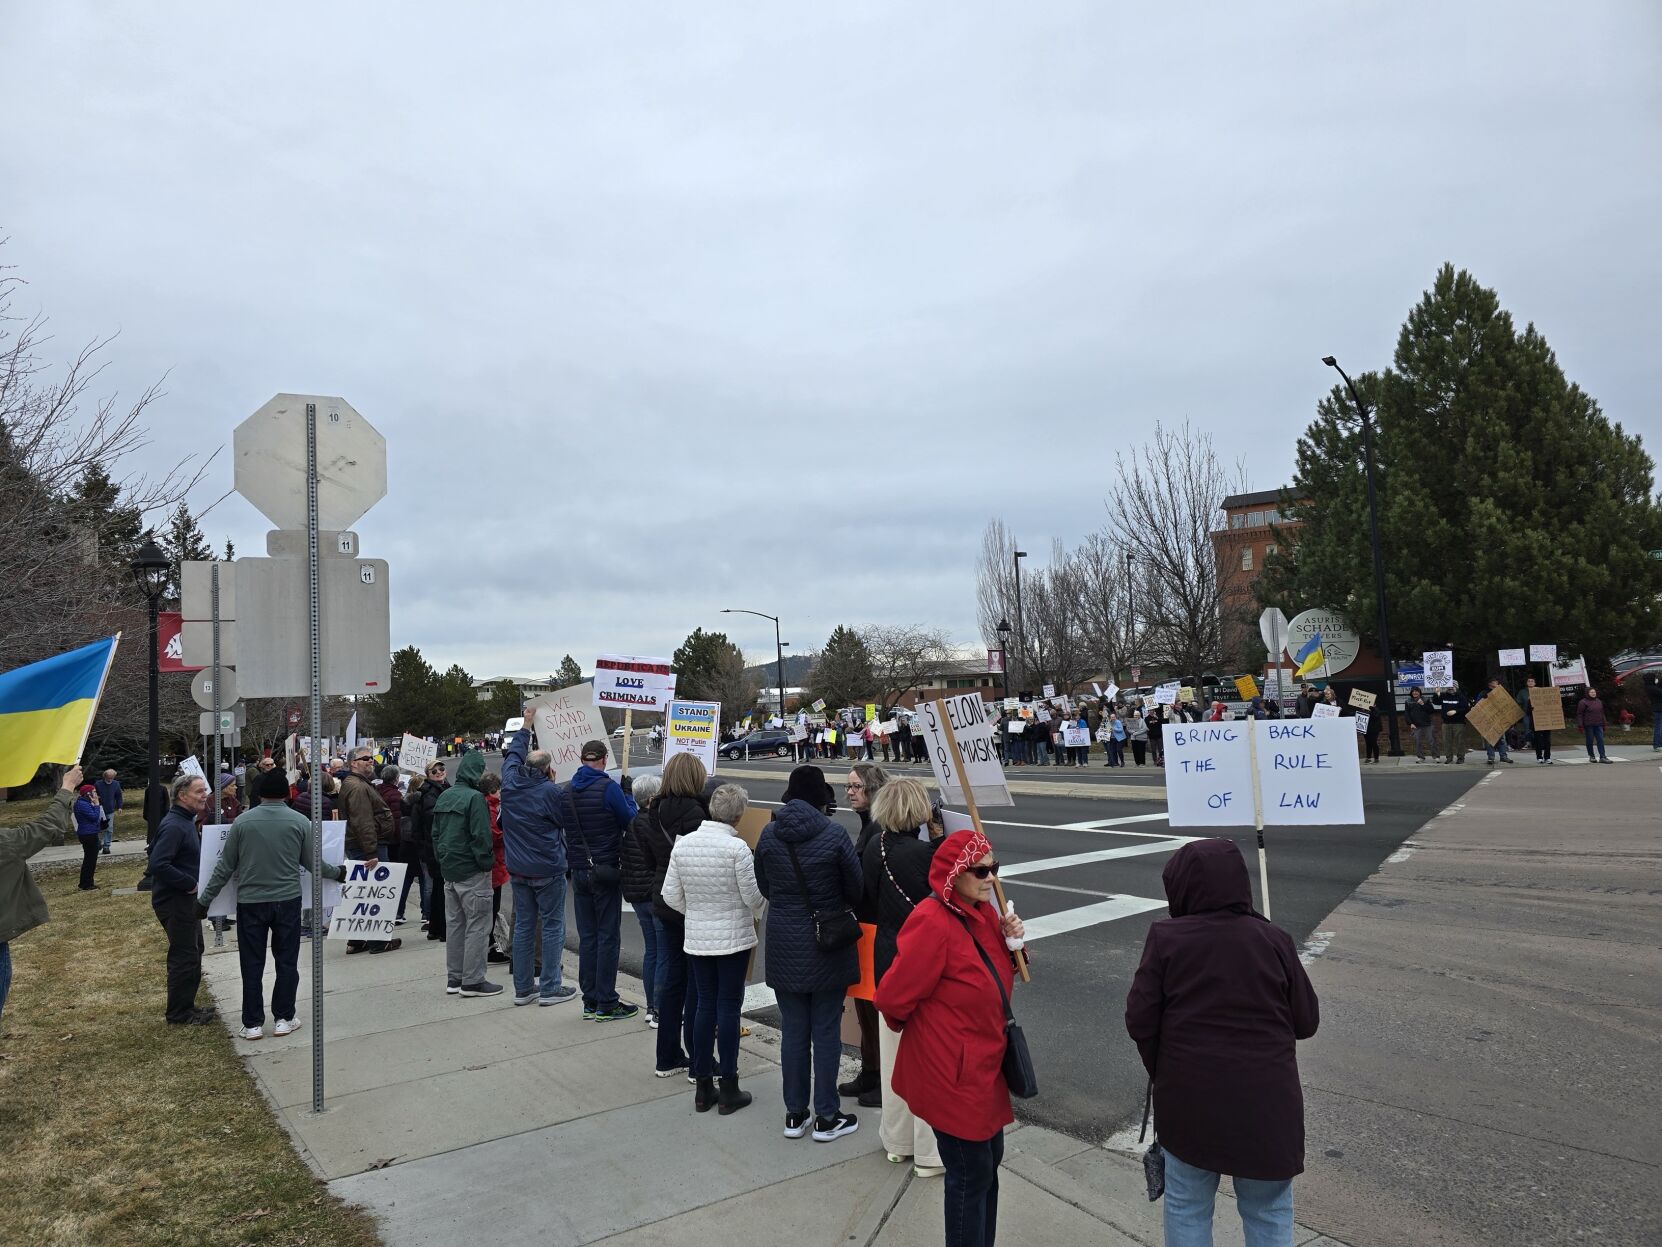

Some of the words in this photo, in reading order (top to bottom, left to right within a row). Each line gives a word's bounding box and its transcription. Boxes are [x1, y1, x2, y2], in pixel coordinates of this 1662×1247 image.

[329, 413, 339, 422] 10
[342, 541, 350, 550] 11
[363, 572, 371, 580] 11
[1304, 616, 1341, 624] ASURIS
[616, 677, 644, 687] LOVE
[544, 696, 574, 712] WE
[599, 691, 657, 704] CRIMINALS
[545, 710, 586, 729] STAND
[678, 708, 709, 716] STAND
[945, 694, 984, 730] ELON
[555, 724, 593, 740] WITH
[675, 724, 711, 733] UKRAINE
[1174, 729, 1238, 746] BRING
[1269, 724, 1316, 739] BACK
[407, 741, 433, 756] SAVE
[924, 703, 951, 786] STOP
[1181, 758, 1216, 773] THE
[1274, 753, 1333, 770] RULE
[1207, 792, 1233, 809] OF
[1279, 792, 1321, 808] LAW
[349, 864, 390, 882] NO
[341, 885, 397, 900] KINGS
[352, 903, 381, 916] NO
[335, 918, 395, 934] TYRANTS
